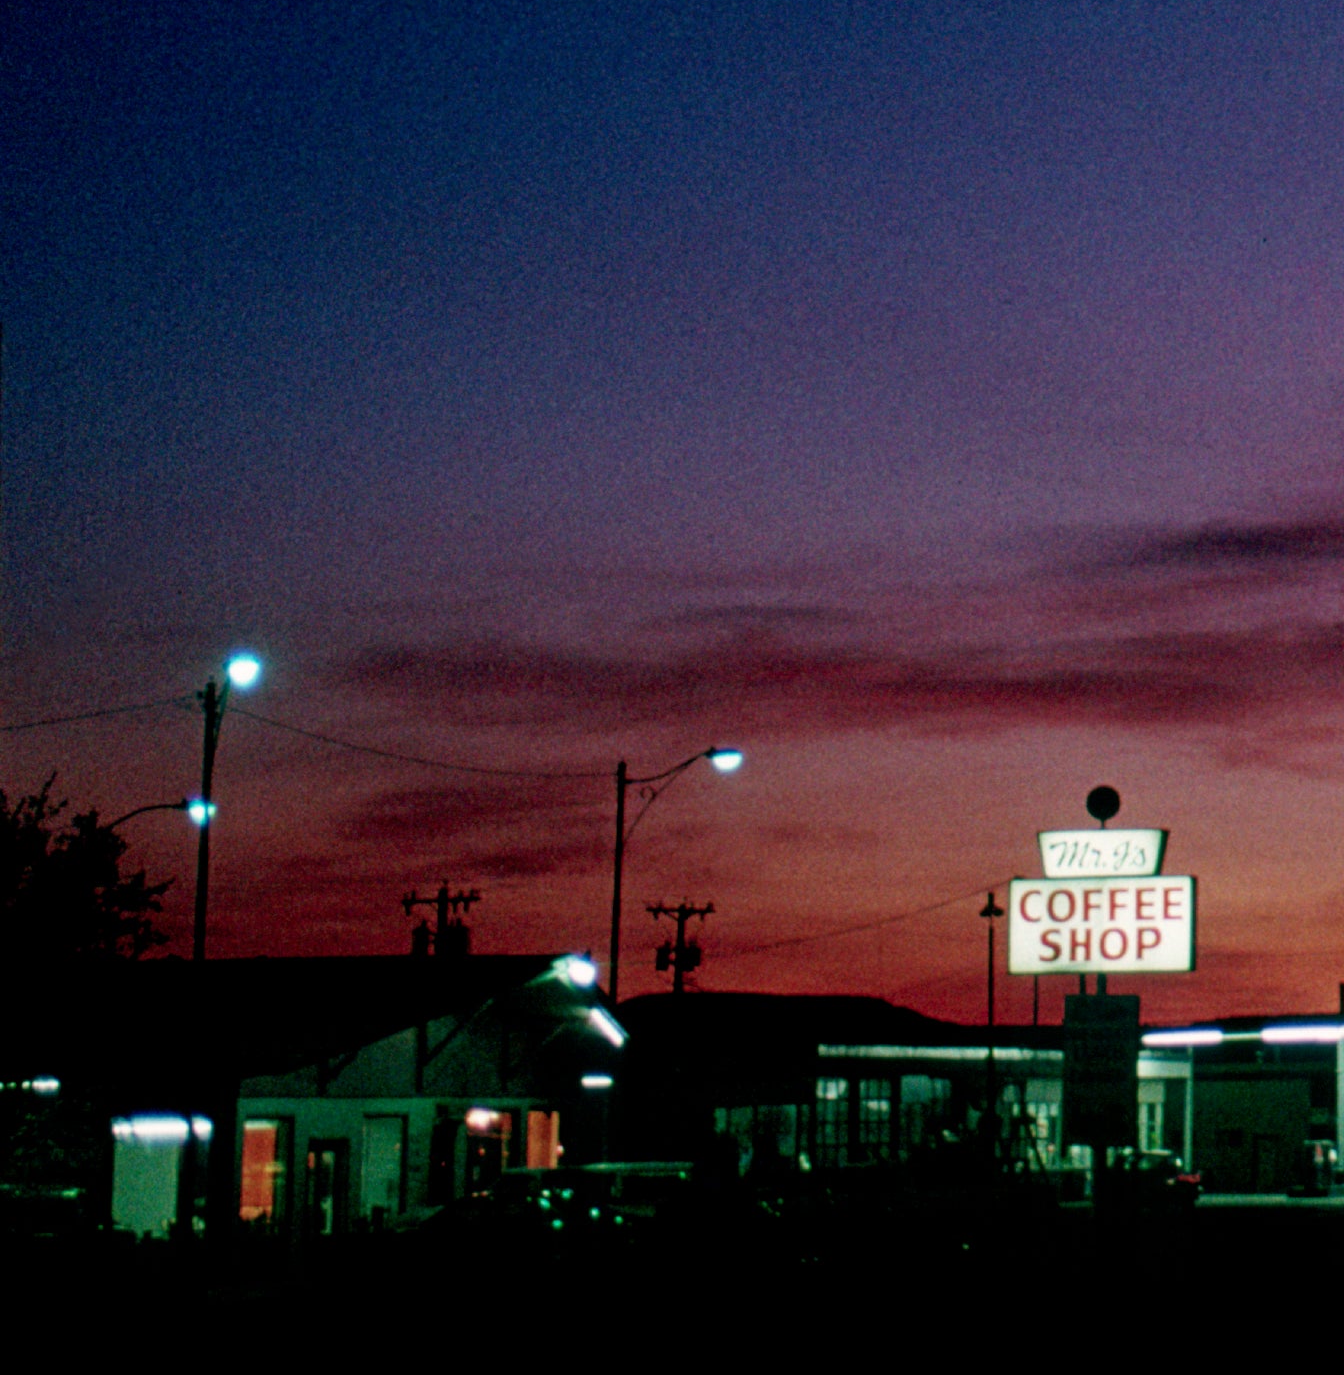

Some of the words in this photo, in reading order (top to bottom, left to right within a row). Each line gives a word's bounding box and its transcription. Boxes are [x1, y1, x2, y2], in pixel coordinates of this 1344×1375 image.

[1049, 840, 1107, 868] Mr.
[1019, 887, 1184, 923] COFFEE
[1039, 926, 1162, 962] SHOP
